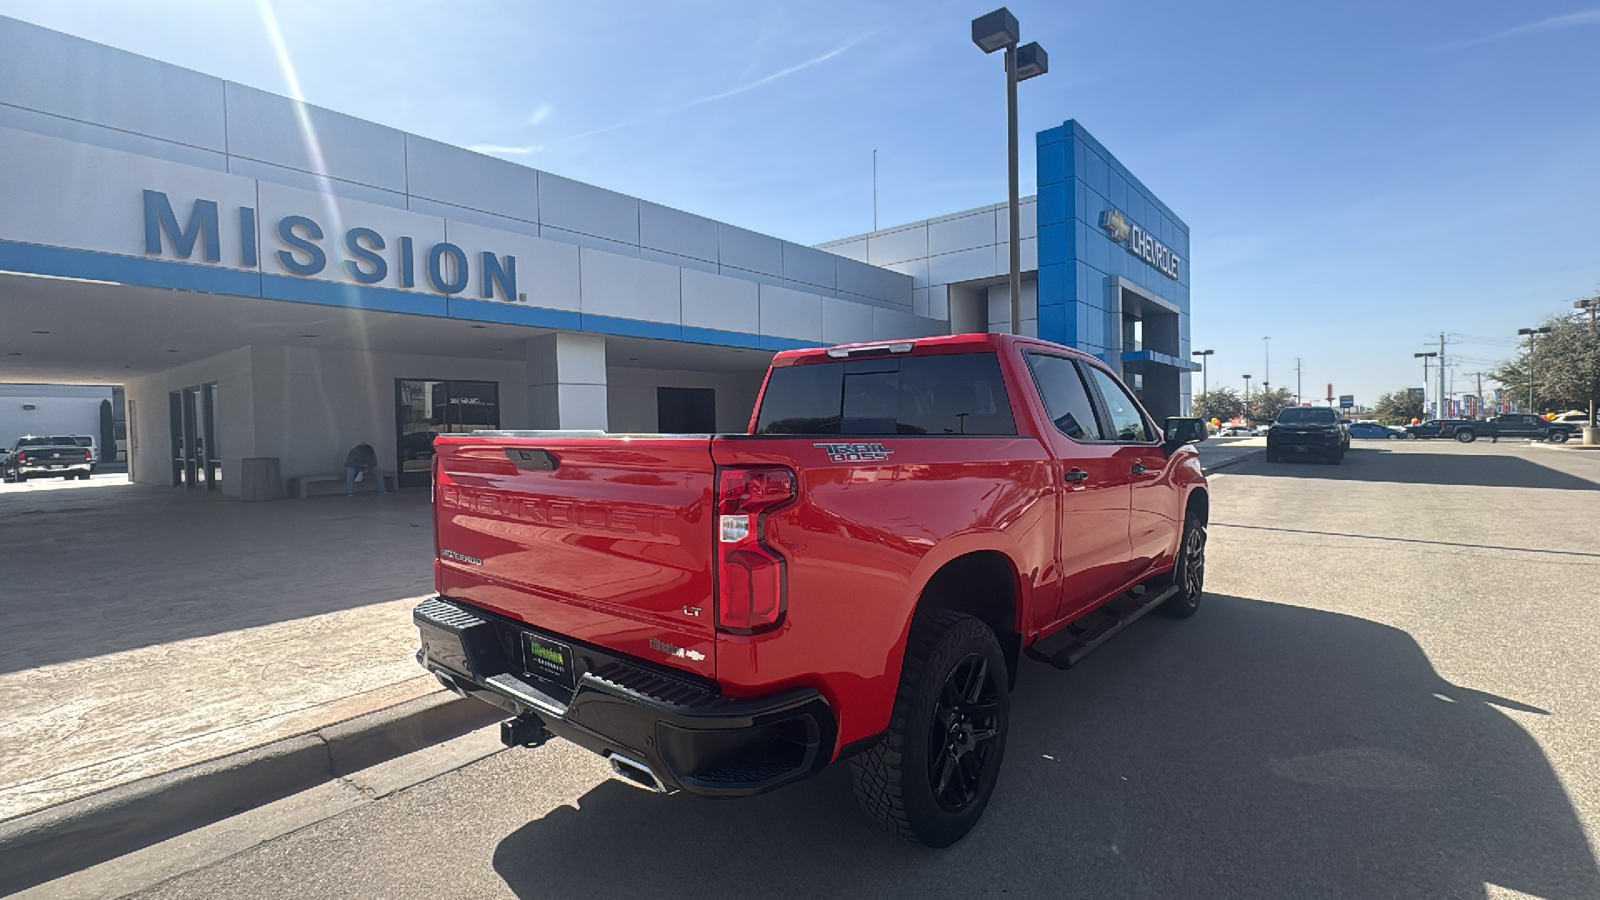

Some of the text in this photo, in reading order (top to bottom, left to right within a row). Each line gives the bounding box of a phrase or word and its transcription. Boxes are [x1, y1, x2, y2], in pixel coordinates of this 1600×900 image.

[1131, 224, 1181, 279] CHEVROLET
[813, 443, 894, 454] TRAIL
[829, 453, 889, 463] BOSS
[442, 488, 676, 538] CHEVROLET
[441, 549, 482, 566] SILVERADO
[683, 605, 702, 617] LT
